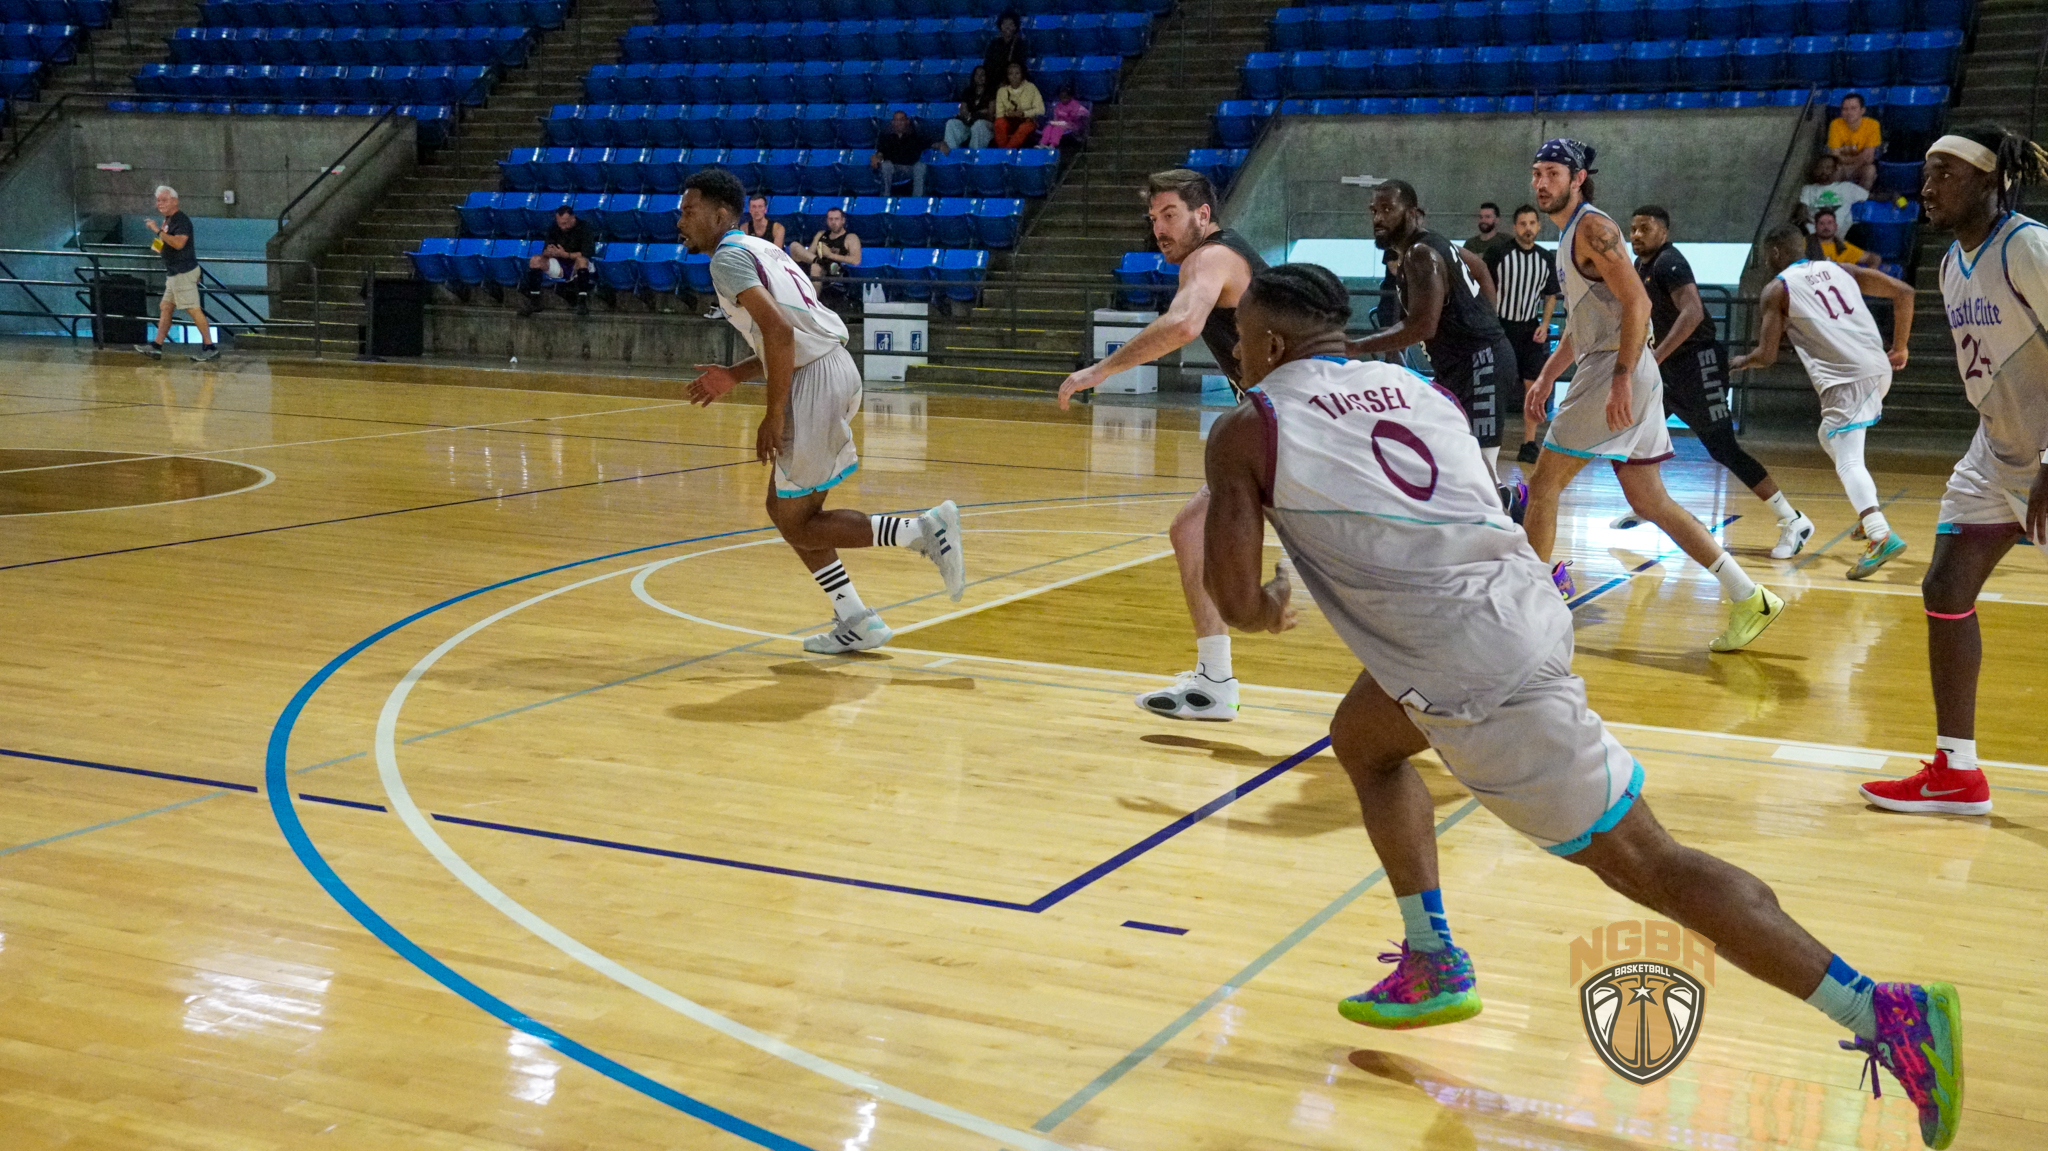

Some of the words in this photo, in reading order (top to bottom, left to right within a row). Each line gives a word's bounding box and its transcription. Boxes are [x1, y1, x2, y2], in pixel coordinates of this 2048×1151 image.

[1805, 268, 1832, 286] BOYD
[1814, 285, 1855, 320] 11
[1974, 295, 2003, 327] Elite
[1472, 346, 1496, 438] ELITE
[1697, 348, 1729, 422] ELITE
[1370, 419, 1439, 502] 0
